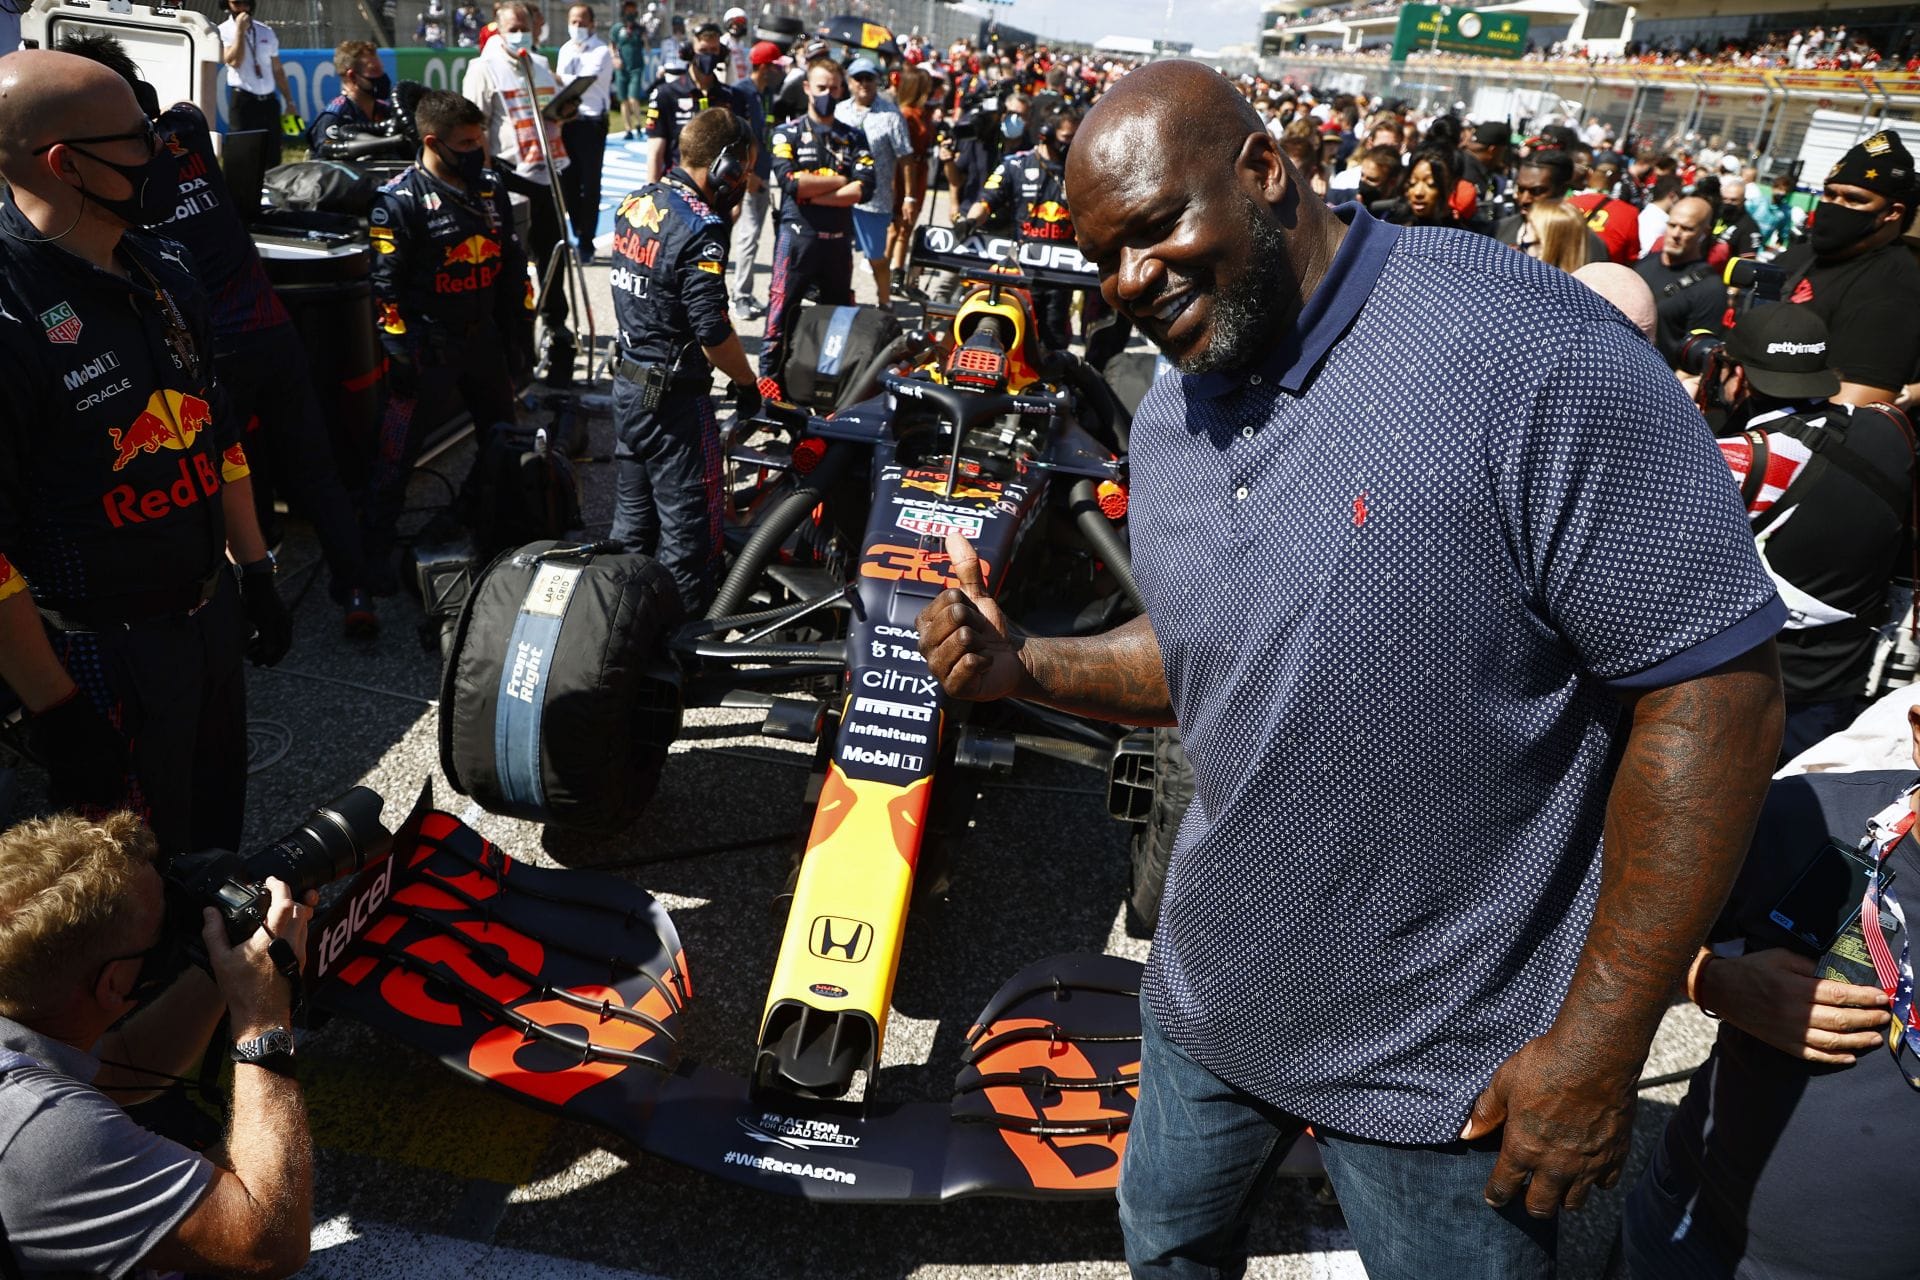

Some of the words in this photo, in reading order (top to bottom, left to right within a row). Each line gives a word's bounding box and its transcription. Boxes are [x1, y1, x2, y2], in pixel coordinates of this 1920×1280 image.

[41, 304, 72, 328] TAG
[47, 318, 81, 343] HEUER
[63, 357, 107, 391] Mobil
[76, 377, 132, 412] ORACLE
[102, 457, 199, 529] Red
[892, 496, 998, 519] HONDA
[911, 510, 977, 528] TAG
[556, 580, 570, 602] GRID
[874, 625, 920, 640] ORAC
[506, 640, 531, 698] Front
[519, 646, 544, 704] Right
[862, 669, 939, 697] citrix
[854, 696, 934, 722] PIRELLI
[842, 745, 900, 768] Mobil
[317, 852, 394, 977] telcel
[759, 1120, 778, 1130] FOR
[777, 1123, 812, 1139] ROAD
[812, 1130, 861, 1147] SAFETY
[760, 1112, 782, 1123] FIA
[783, 1116, 840, 1135] ACTION
[723, 1150, 857, 1185] #WeRaceAsOne
